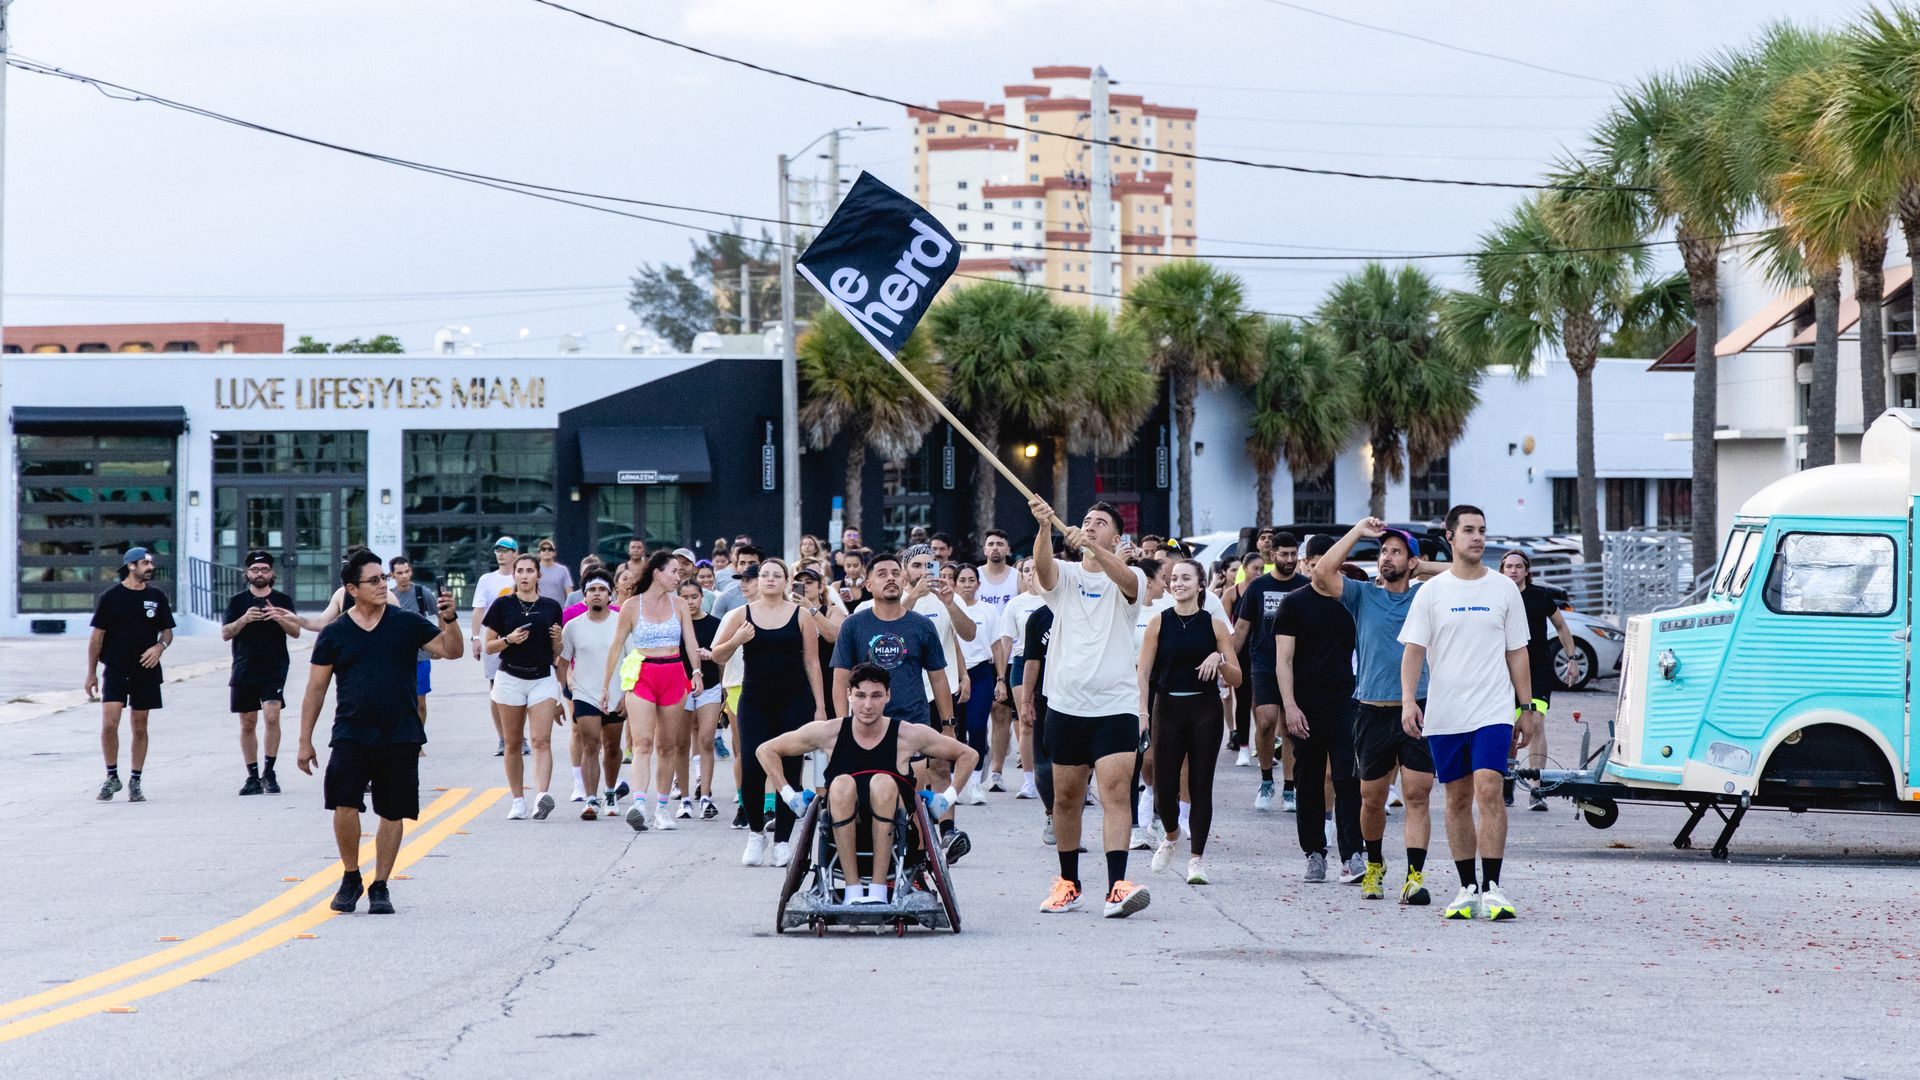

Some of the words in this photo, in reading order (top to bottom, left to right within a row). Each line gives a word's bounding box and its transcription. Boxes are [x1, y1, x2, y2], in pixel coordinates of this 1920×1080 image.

[844, 218, 953, 338] herd
[214, 377, 285, 409] LUXE
[295, 377, 441, 409] LIFESTYLES
[451, 377, 545, 409] MIAMI
[874, 646, 900, 654] MIAMI
